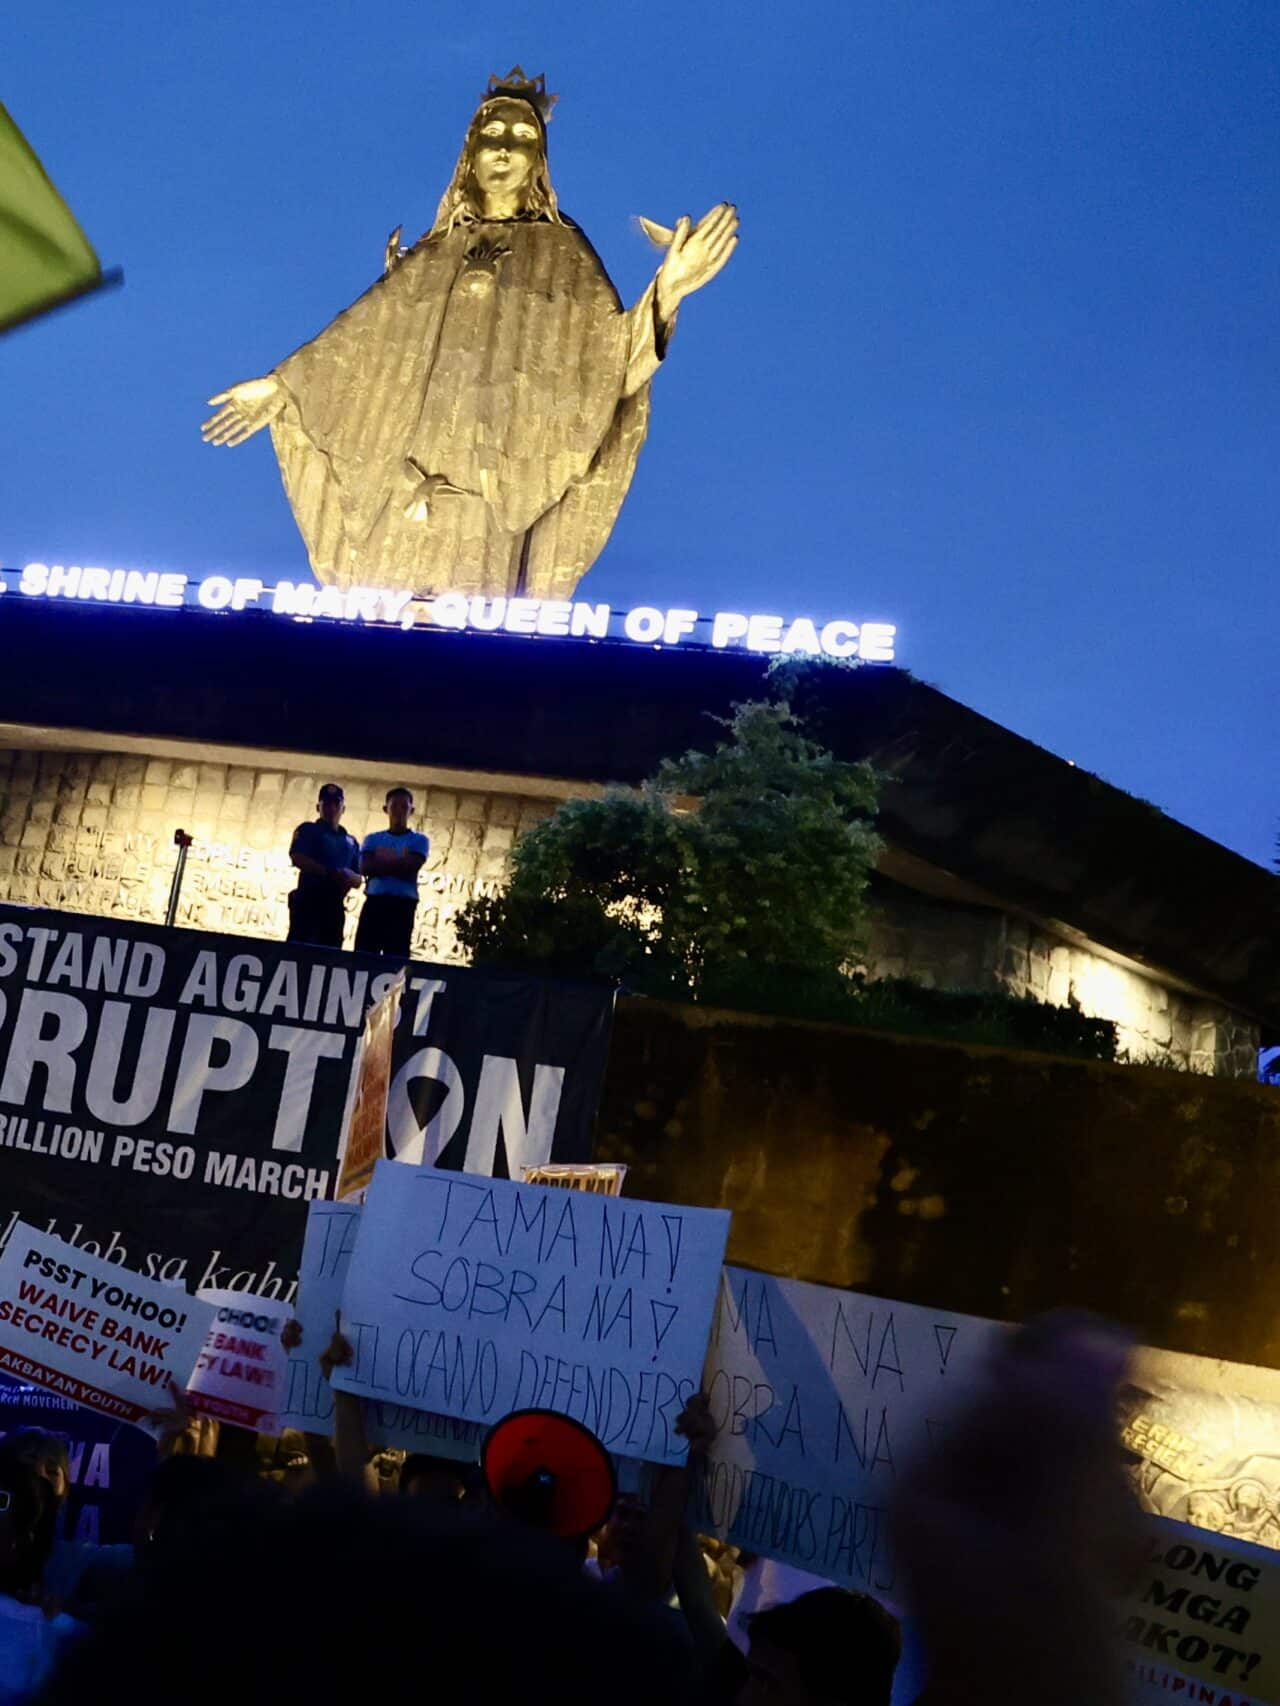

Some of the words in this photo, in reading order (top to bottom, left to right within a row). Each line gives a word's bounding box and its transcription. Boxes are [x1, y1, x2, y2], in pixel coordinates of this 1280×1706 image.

[20, 562, 187, 607] SHRINE
[198, 576, 263, 612] OF
[272, 580, 415, 630] MARY,
[426, 592, 611, 638] QUEEN
[624, 605, 698, 644] OF
[711, 611, 897, 663] PEACE
[111, 1135, 196, 1180] PESO
[203, 1151, 330, 1201] MARCH
[416, 1175, 578, 1267] TAMA
[19, 1280, 99, 1330] WAIVE
[100, 1317, 169, 1360] BANK
[24, 1249, 86, 1289] PSST
[91, 1277, 187, 1333] YOHOO!
[393, 1250, 566, 1333] SOBRA
[79, 1386, 134, 1417] YOUTH
[108, 1350, 172, 1389] LAW!
[344, 1322, 499, 1416] ILOCANO
[709, 1369, 805, 1456] OBRA
[1143, 1578, 1250, 1634] MGA
